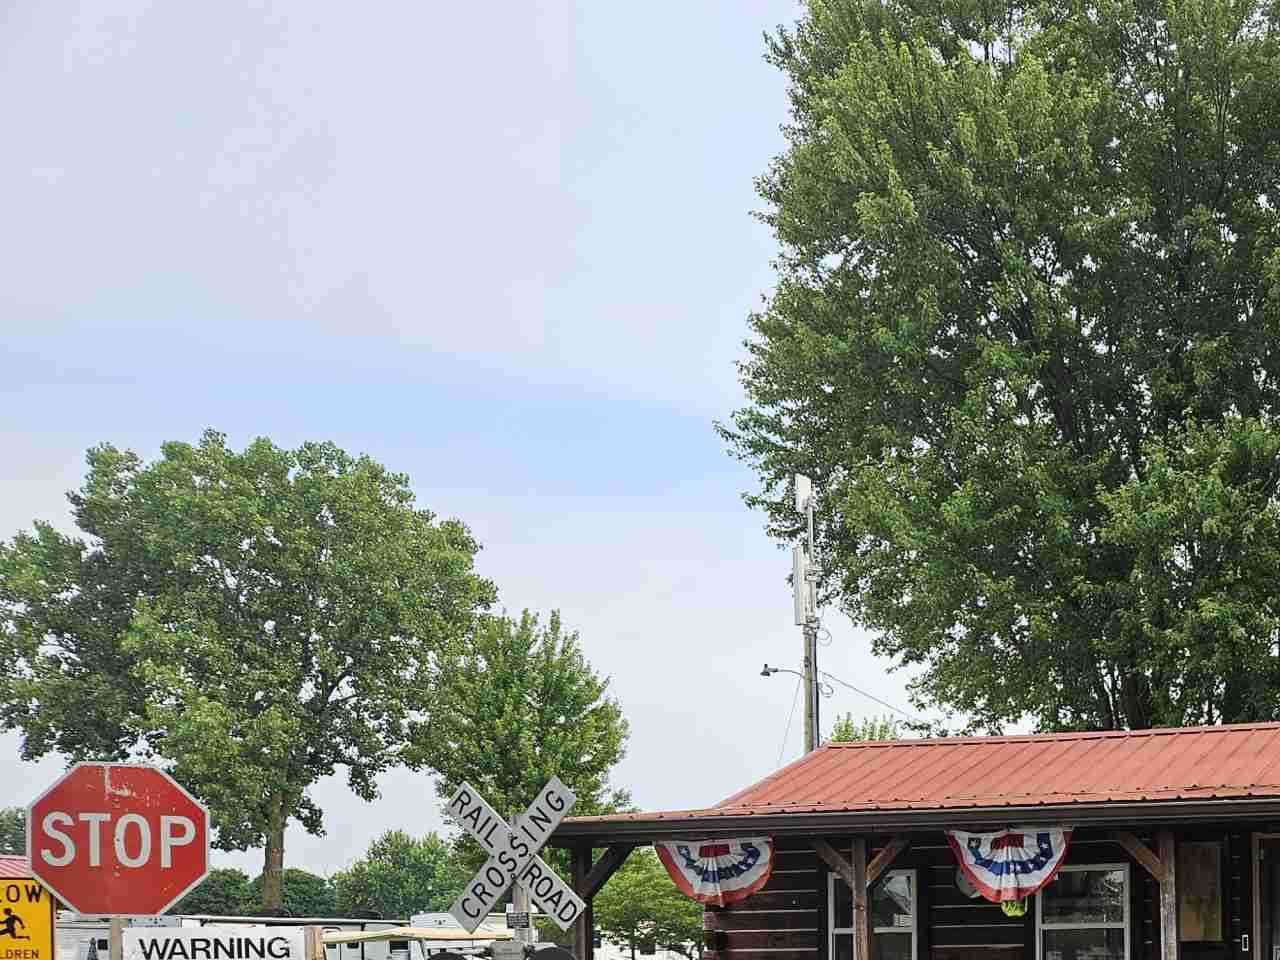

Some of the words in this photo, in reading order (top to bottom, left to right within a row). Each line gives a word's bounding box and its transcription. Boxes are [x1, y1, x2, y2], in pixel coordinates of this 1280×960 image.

[41, 811, 196, 868] STOP
[451, 790, 499, 849] RAIL
[522, 863, 577, 922] ROAD
[461, 789, 565, 919] CROSSING
[0, 884, 42, 903] OW
[138, 936, 290, 960] WARNING
